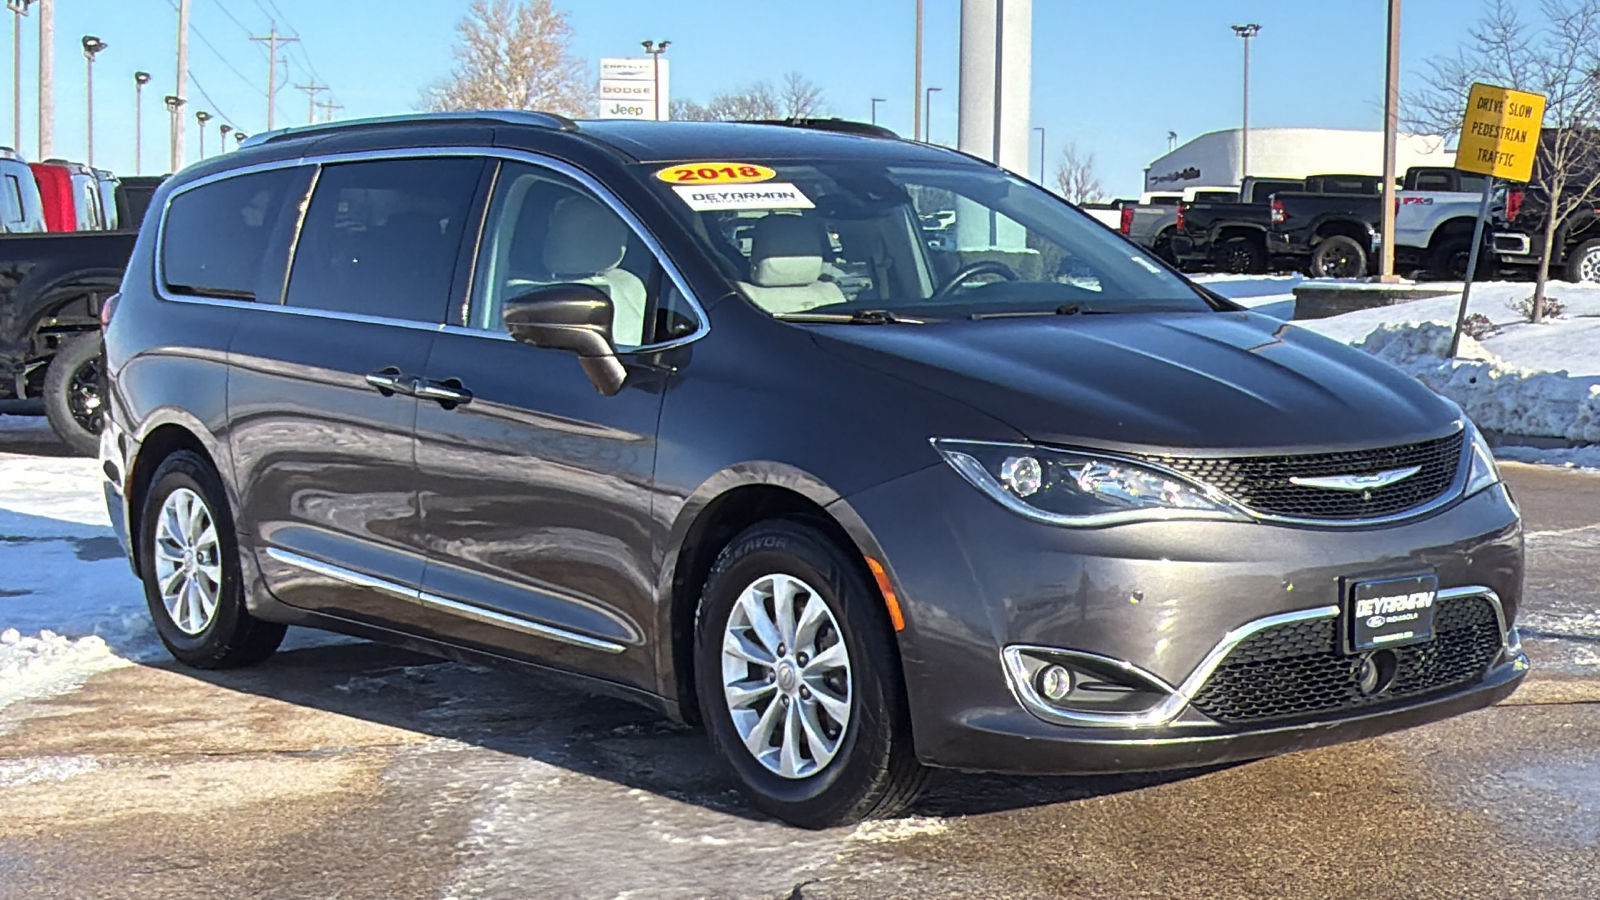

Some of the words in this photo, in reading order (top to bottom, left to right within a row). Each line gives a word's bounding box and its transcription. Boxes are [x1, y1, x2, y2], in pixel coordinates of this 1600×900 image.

[610, 103, 644, 116] Jeep
[1476, 96, 1504, 114] DRIVE
[1508, 101, 1534, 119] SLOW
[1471, 121, 1527, 143] PEDESTRIAN
[1477, 148, 1515, 167] TRAFFIC
[674, 166, 762, 182] 2018
[692, 192, 796, 201] DEYARMAN
